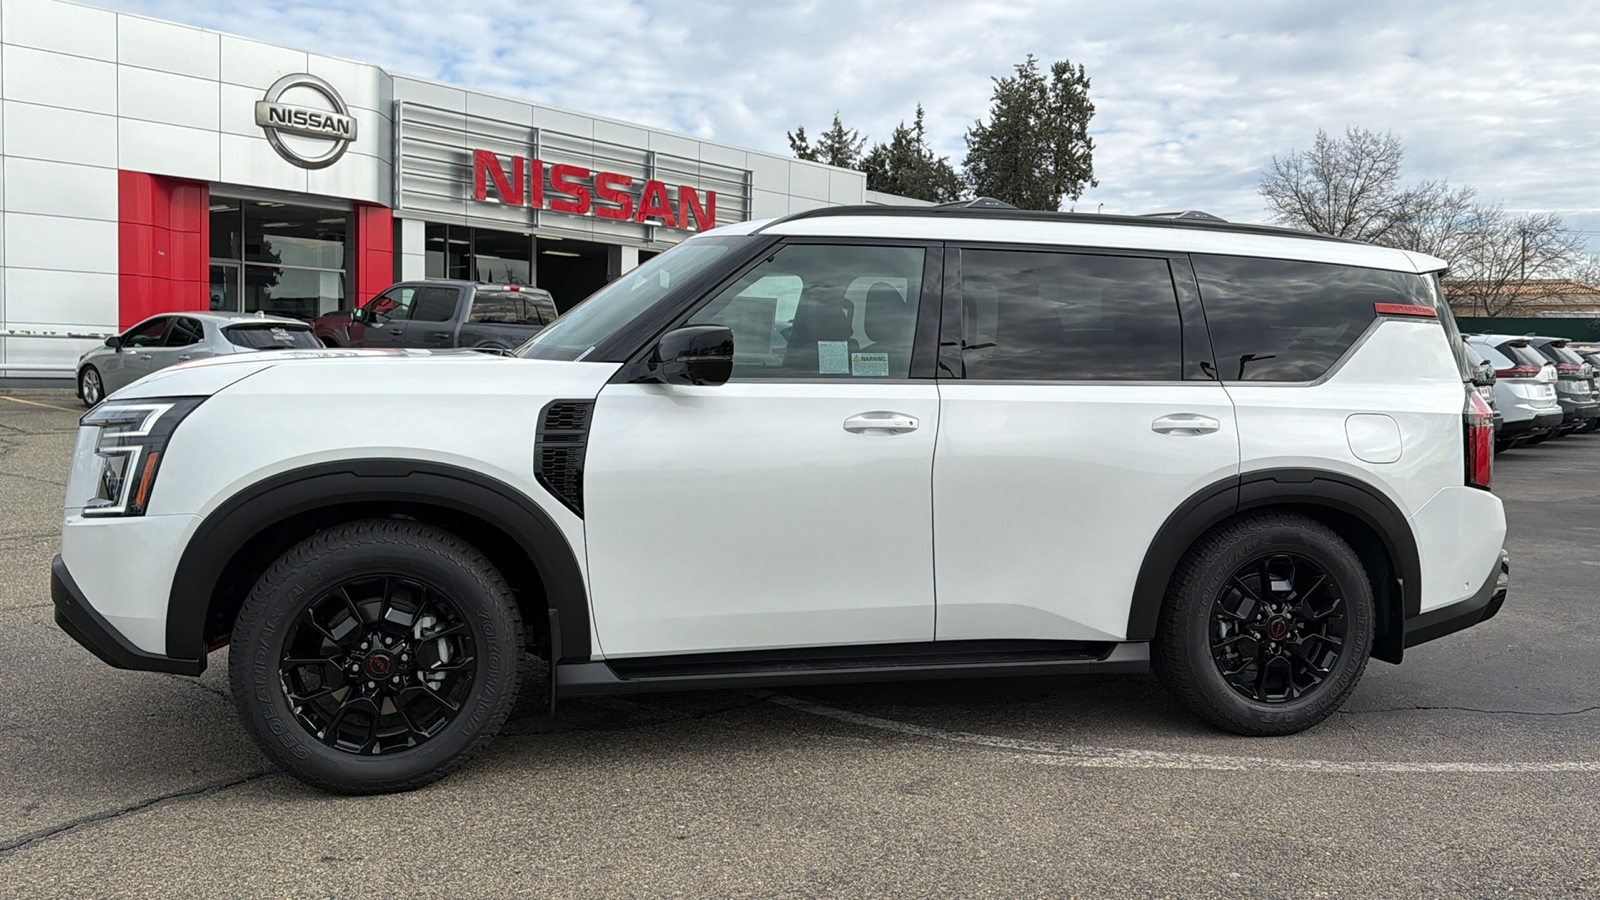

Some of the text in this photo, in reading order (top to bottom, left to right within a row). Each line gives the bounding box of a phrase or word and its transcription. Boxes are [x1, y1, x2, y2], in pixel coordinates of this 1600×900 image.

[269, 106, 350, 134] NISSAN
[473, 148, 716, 231] NISSAN
[254, 607, 312, 760] GEOLANDAR
[460, 604, 500, 739] YOKOHAMA
